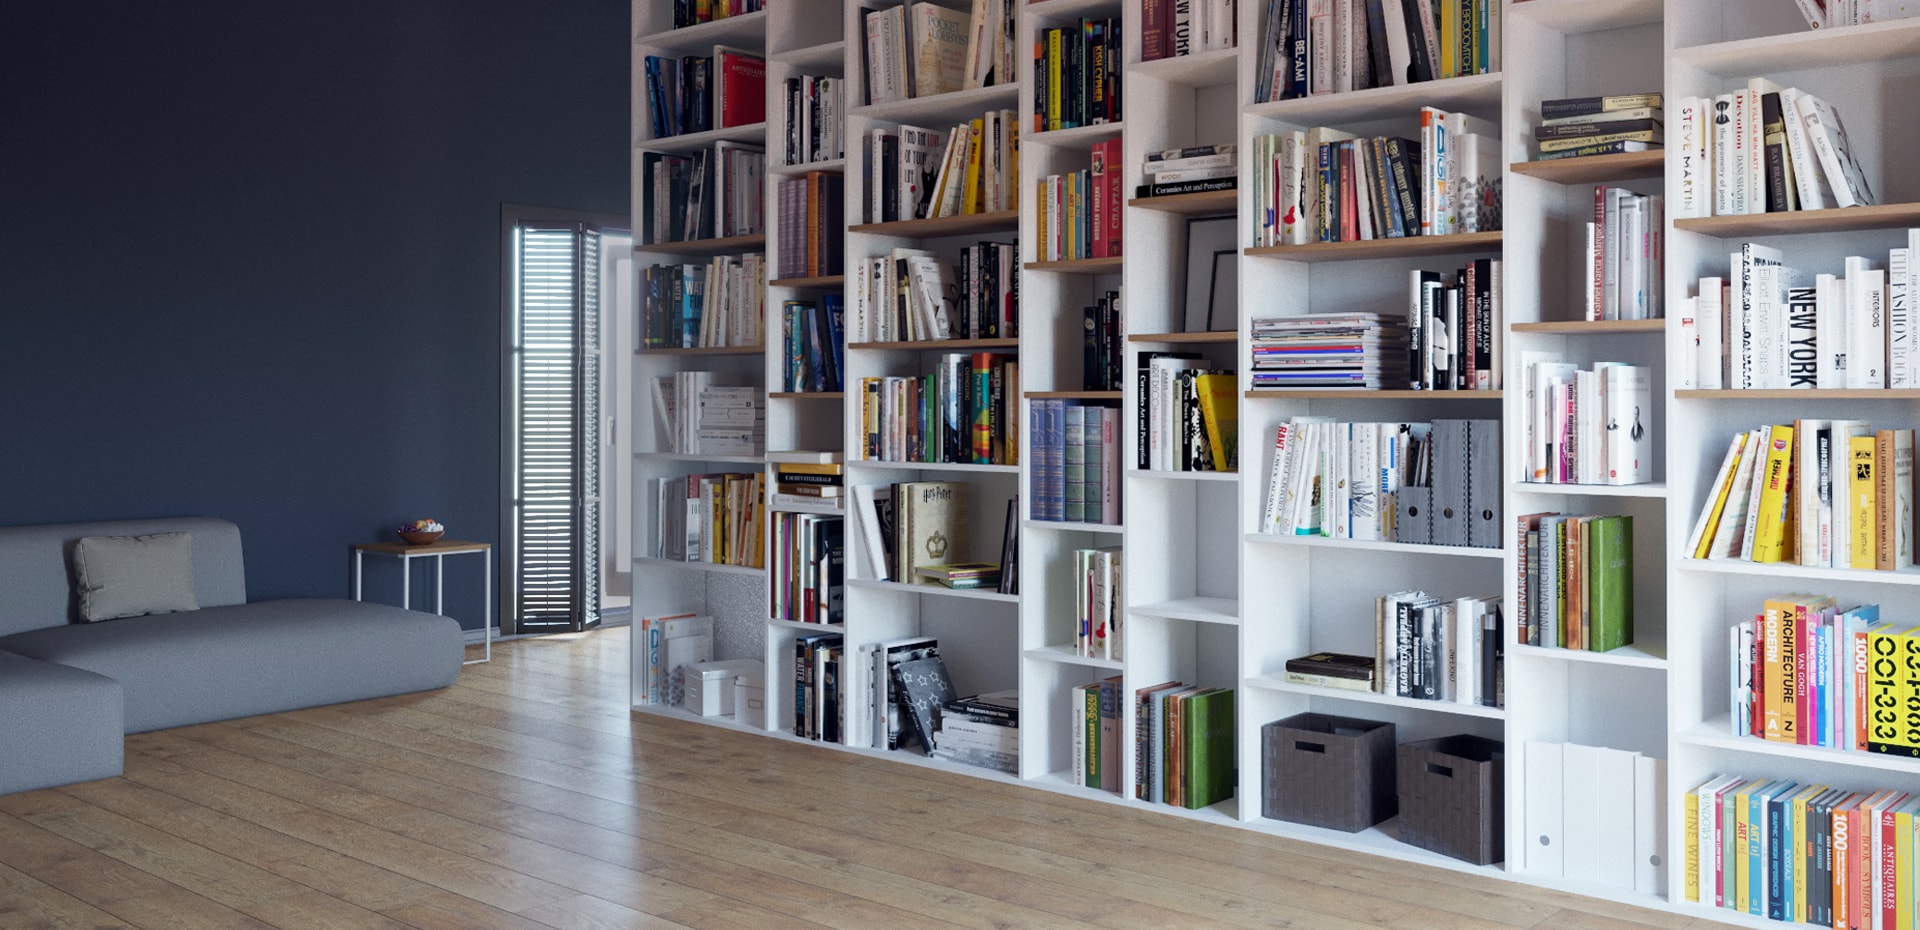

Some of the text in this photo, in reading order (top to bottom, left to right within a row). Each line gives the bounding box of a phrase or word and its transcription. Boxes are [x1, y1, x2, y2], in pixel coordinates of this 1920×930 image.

[927, 16, 960, 33] POCKET
[1177, 20, 1189, 56] YORK
[1463, 8, 1472, 71] BRODOVITCH
[1094, 45, 1103, 102] KISH CYPHER
[1296, 40, 1305, 81] BEL-AMI
[905, 130, 939, 147] FIND THE LOVE
[1753, 124, 1759, 134] HA
[1791, 130, 1802, 160] MARTIN
[905, 149, 926, 165] OF YOUR
[1683, 108, 1692, 210] STEVE MARTIN
[905, 169, 914, 183] LIFE
[1156, 186, 1182, 194] Ceramics
[1204, 182, 1232, 190] Perception
[1719, 179, 1726, 187] of
[1771, 147, 1783, 209] RAY BRADBURY
[1111, 176, 1119, 229] СПАРТАК
[1385, 207, 1393, 229] МИРЫ
[1466, 268, 1474, 295] Gabriel
[1758, 268, 1771, 299] Elliott
[1759, 302, 1771, 335] Erwitt
[1872, 290, 1880, 328] INTERIORS
[1892, 250, 1909, 386] THE FASHION BOOK
[1483, 325, 1489, 333] OF
[1789, 289, 1817, 387] NEW YORK
[1759, 337, 1771, 375] Snaps
[1870, 369, 1877, 378] 2
[1275, 426, 1287, 450] RANT
[1769, 459, 1782, 490] ПИГМЕЙ
[923, 486, 952, 503] Harry Potter
[1518, 521, 1527, 628] INNENARCHITEKTUR
[1540, 524, 1549, 631] INNENARCHITEKTUR
[1767, 609, 1777, 663] MODERN
[1399, 645, 1409, 693] MAGNETIC
[1756, 642, 1765, 668] Graphic
[1783, 610, 1793, 704] ARCHITECTURE
[1855, 637, 1867, 673] 1000
[797, 657, 805, 715] WATER FINANCE
[1757, 670, 1765, 694] Design
[1874, 637, 1896, 738] 001-333
[1768, 718, 1778, 730] A
[1785, 721, 1793, 732] Z
[1702, 793, 1711, 841] WINDOWS
[1738, 822, 1747, 841] ART
[1751, 823, 1759, 844] ART
[1833, 813, 1848, 850] 1000
[1688, 809, 1698, 887] FINE WINES
[1862, 835, 1870, 918] BOOK SYMBOLS
[1886, 844, 1894, 909] ANTIQUAIRES
